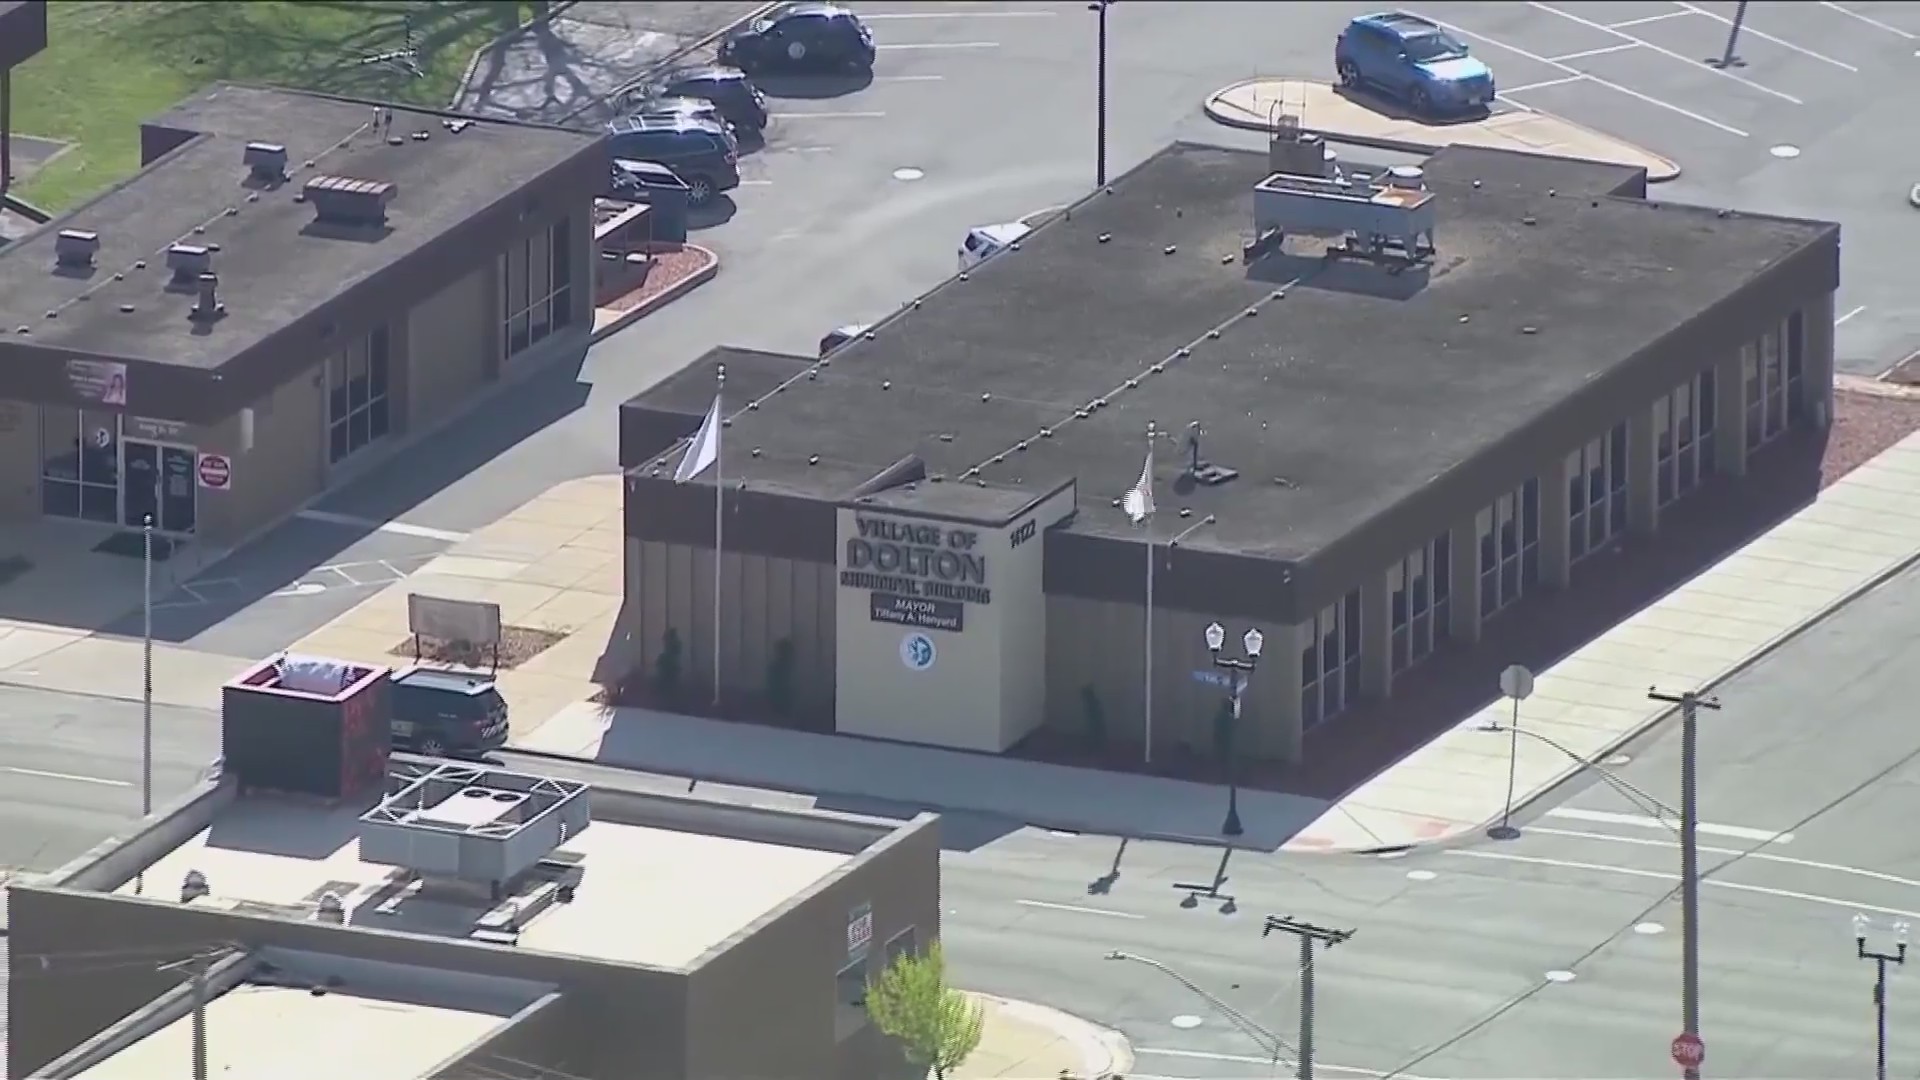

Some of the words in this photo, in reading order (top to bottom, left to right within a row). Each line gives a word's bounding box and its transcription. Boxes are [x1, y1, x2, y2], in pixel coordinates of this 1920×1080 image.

[856, 518, 940, 547] VILLAGE
[947, 529, 977, 549] OF
[847, 538, 985, 584] DOLTON
[895, 599, 935, 613] MAYOR
